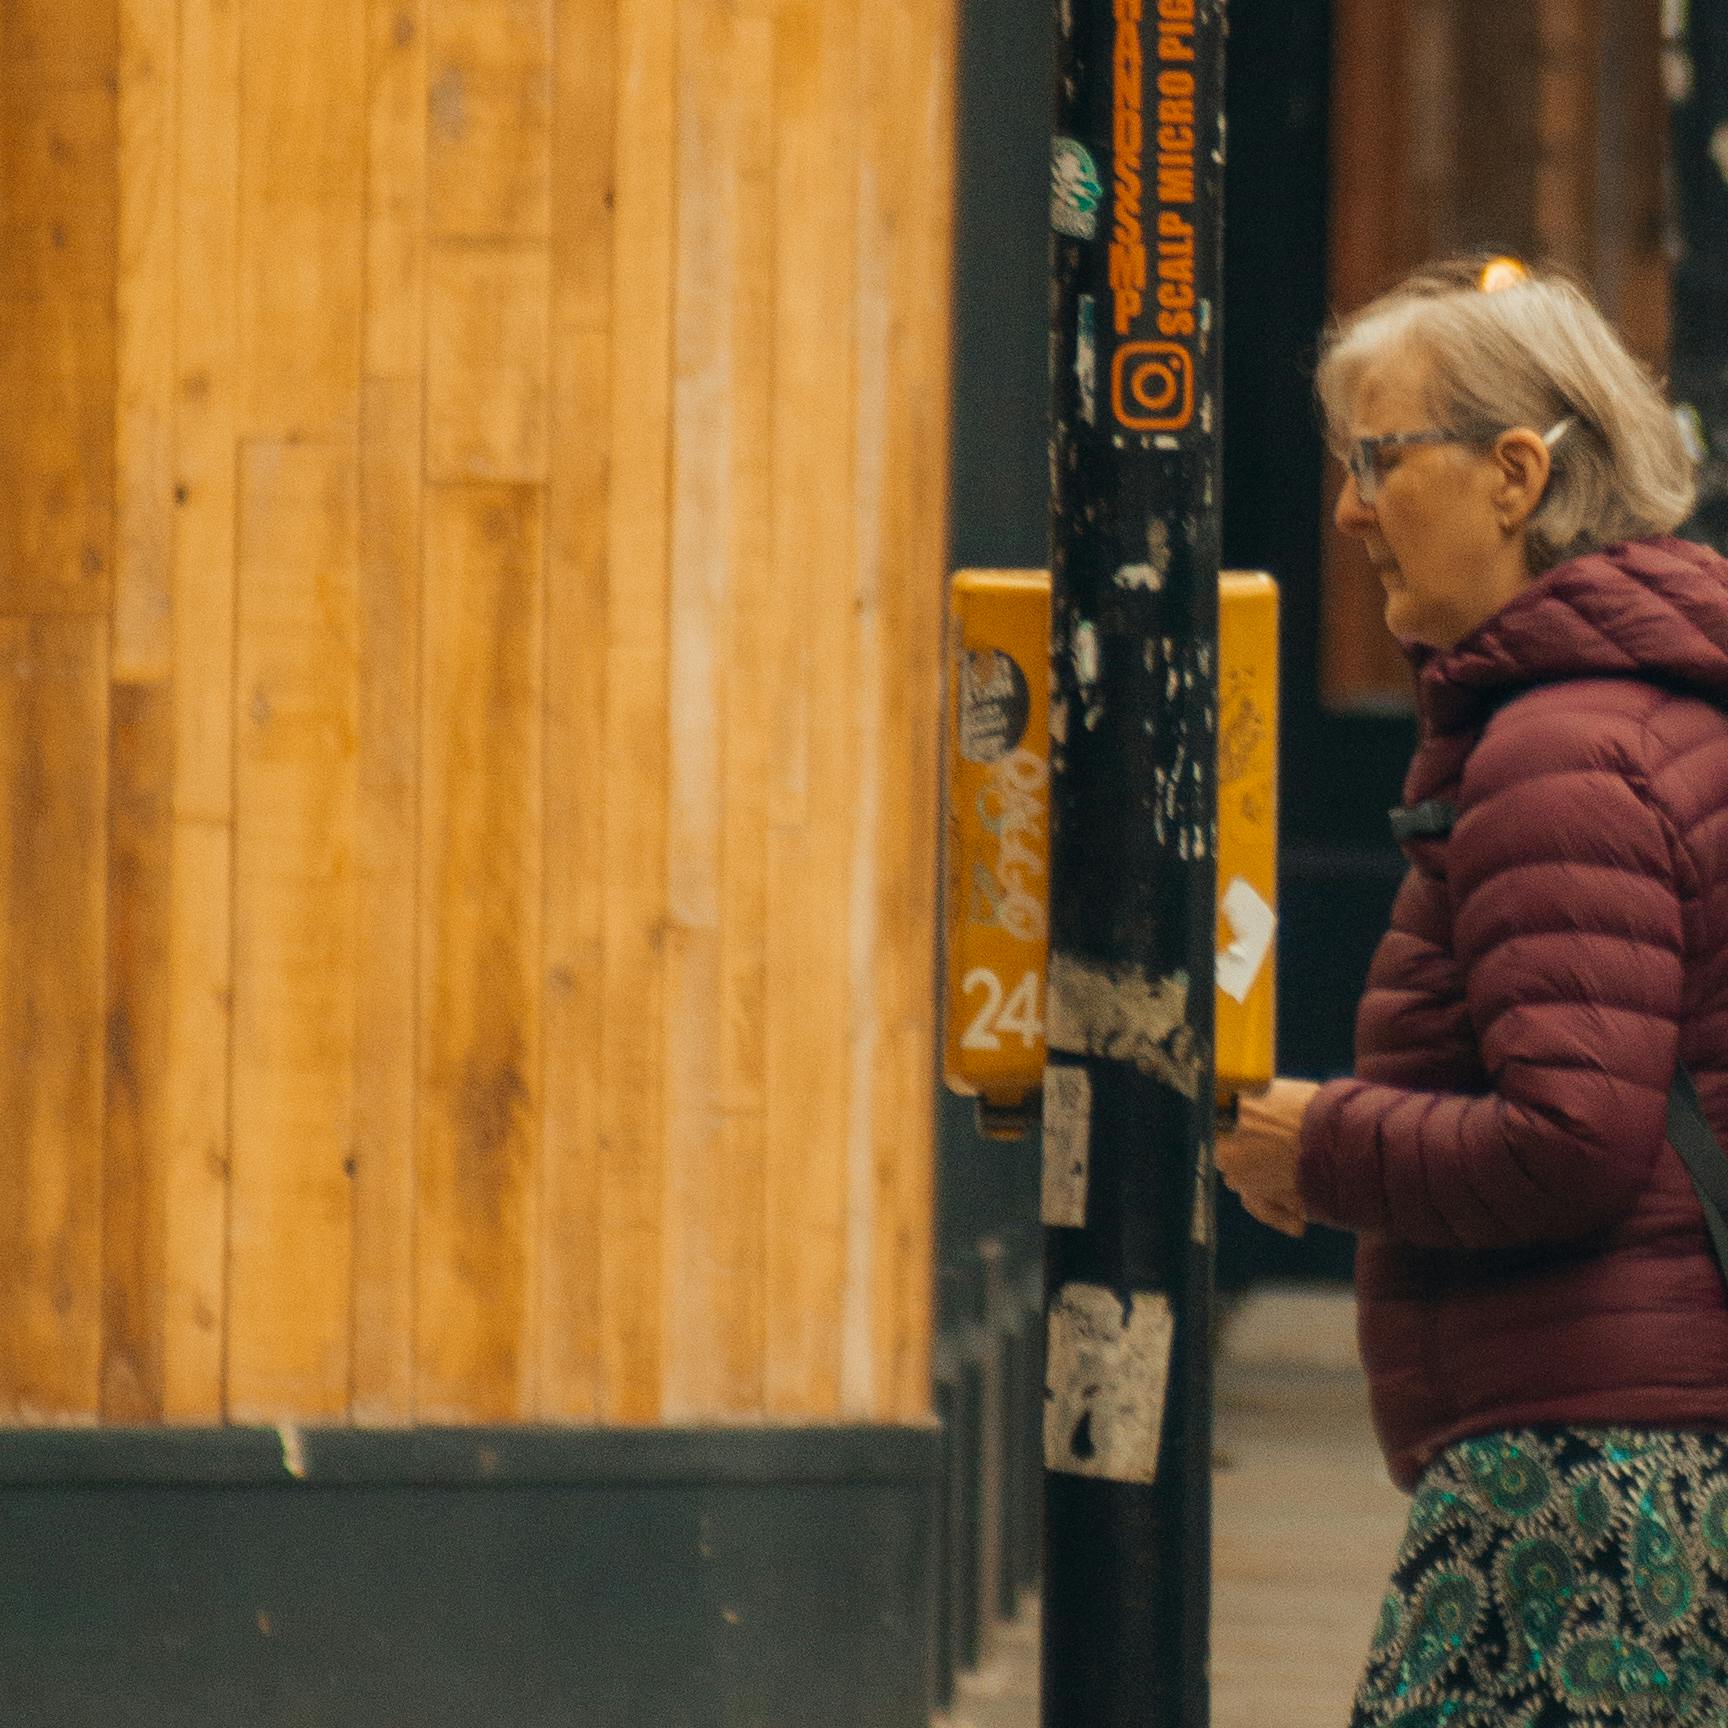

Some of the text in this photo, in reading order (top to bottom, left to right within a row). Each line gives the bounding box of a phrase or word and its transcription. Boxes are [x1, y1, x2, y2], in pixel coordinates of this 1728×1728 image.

[1157, 70, 1195, 203] MICRO
[1157, 210, 1195, 336] SCALP
[960, 967, 1043, 1049] 24
